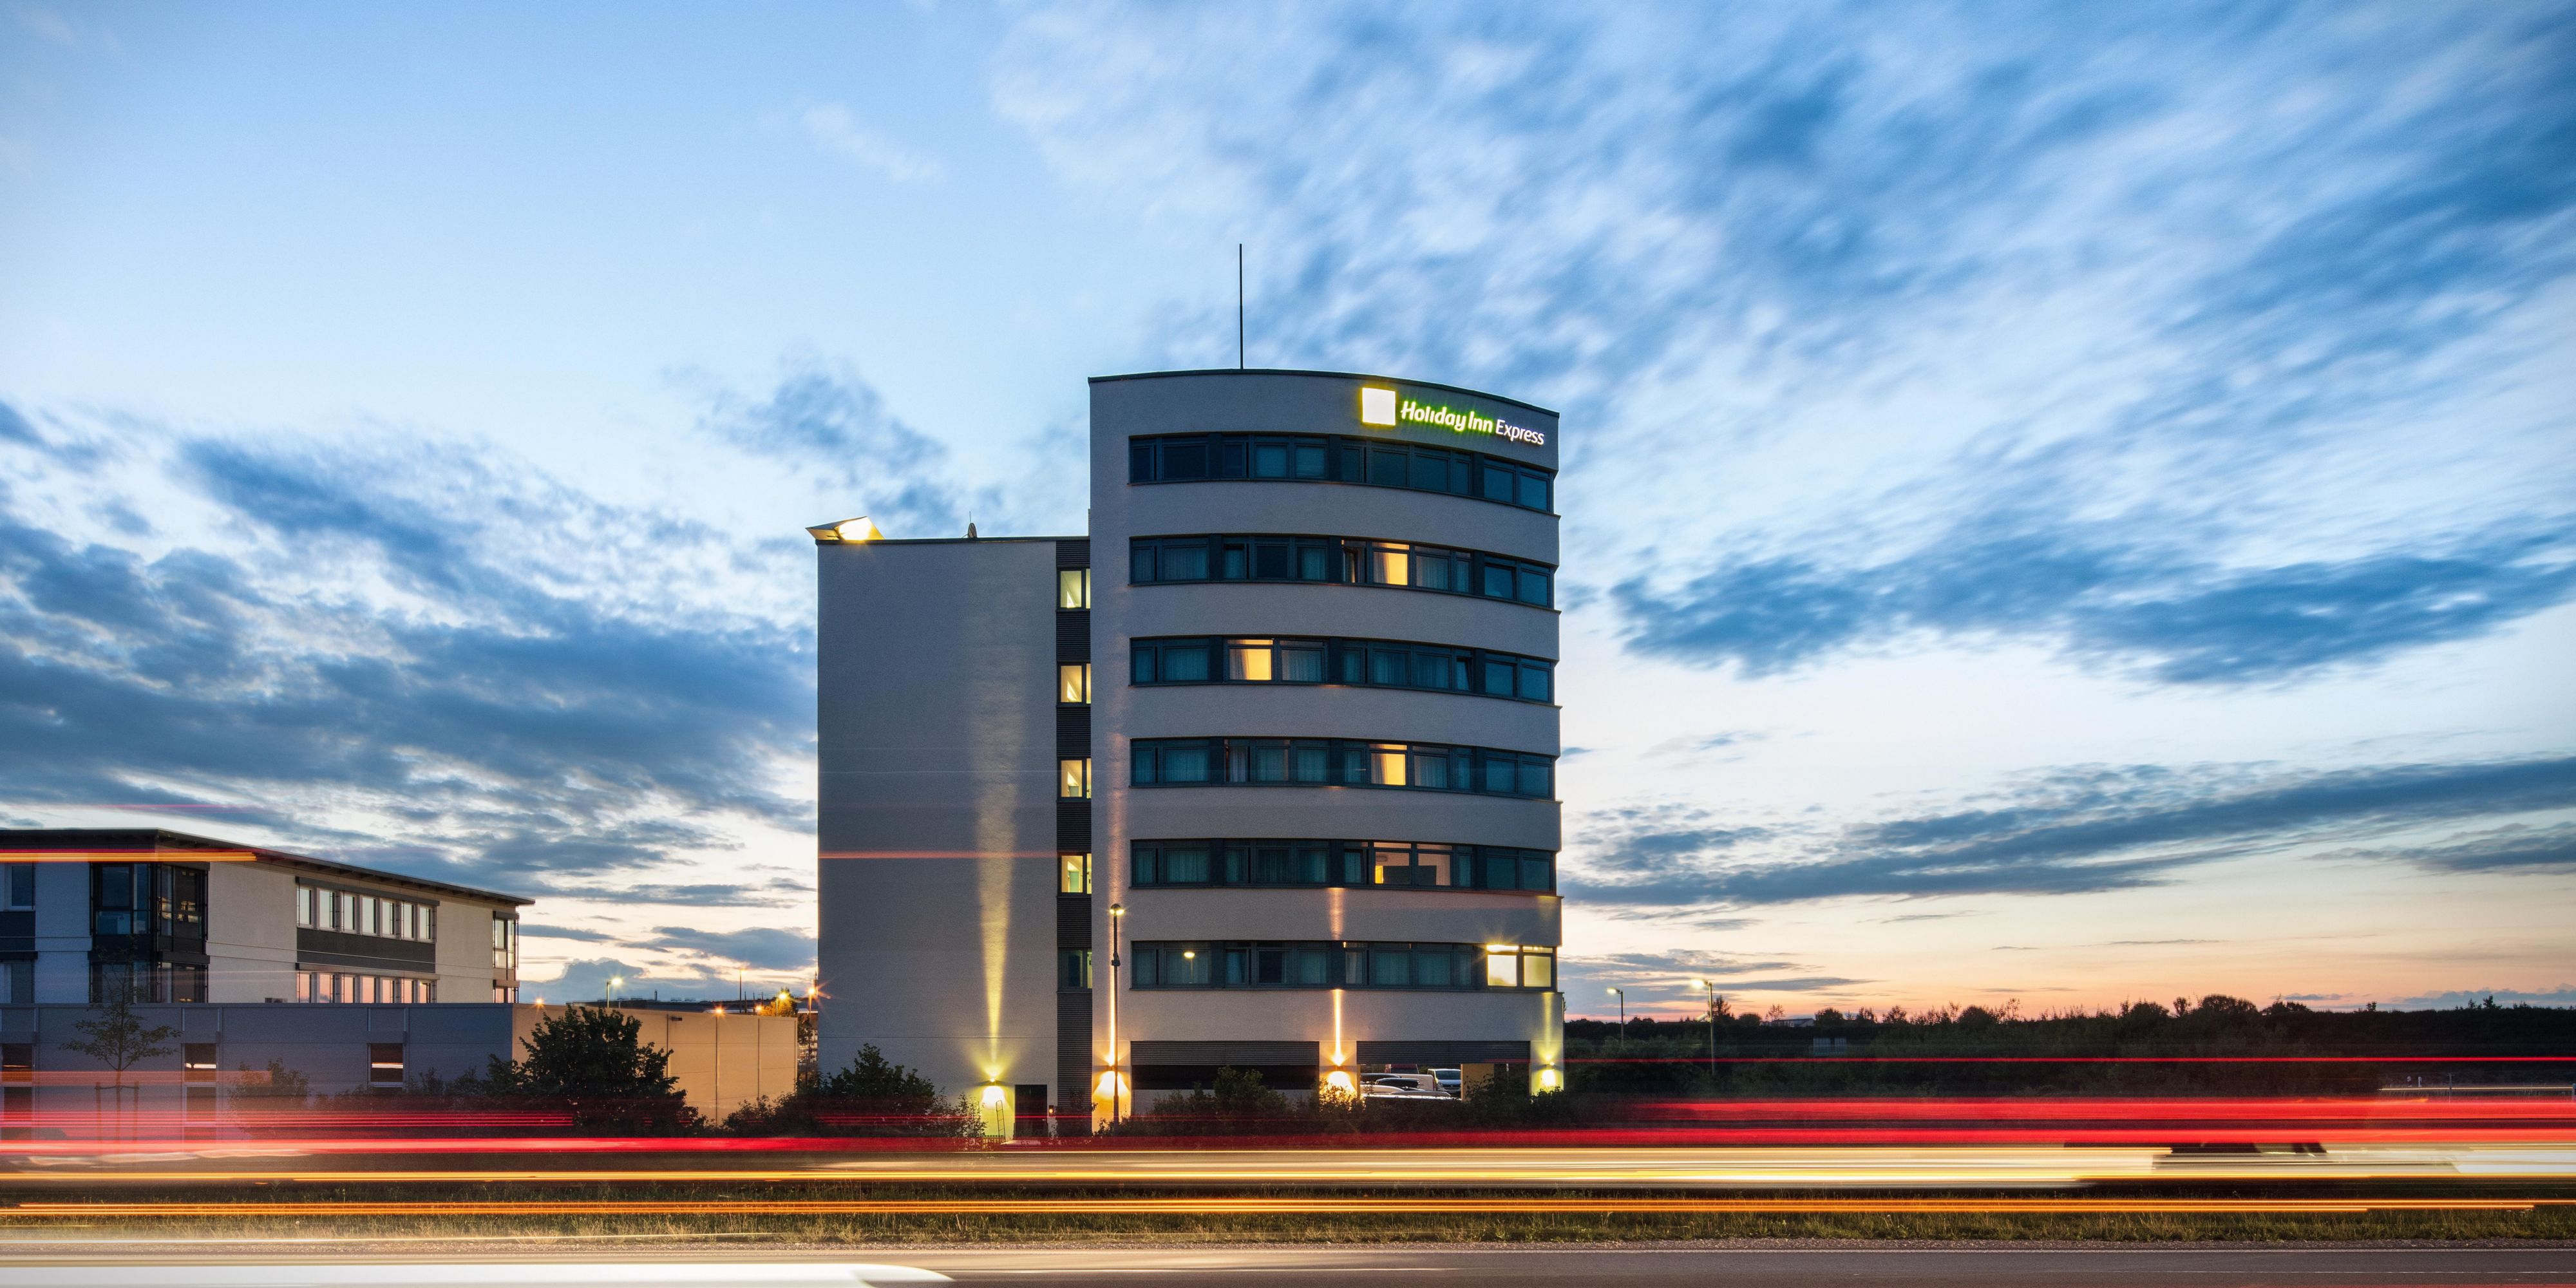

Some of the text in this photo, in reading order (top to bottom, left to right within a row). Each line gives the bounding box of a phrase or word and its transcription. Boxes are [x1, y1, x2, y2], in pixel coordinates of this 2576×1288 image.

[1400, 400, 1544, 445] Holiday Inn Express
